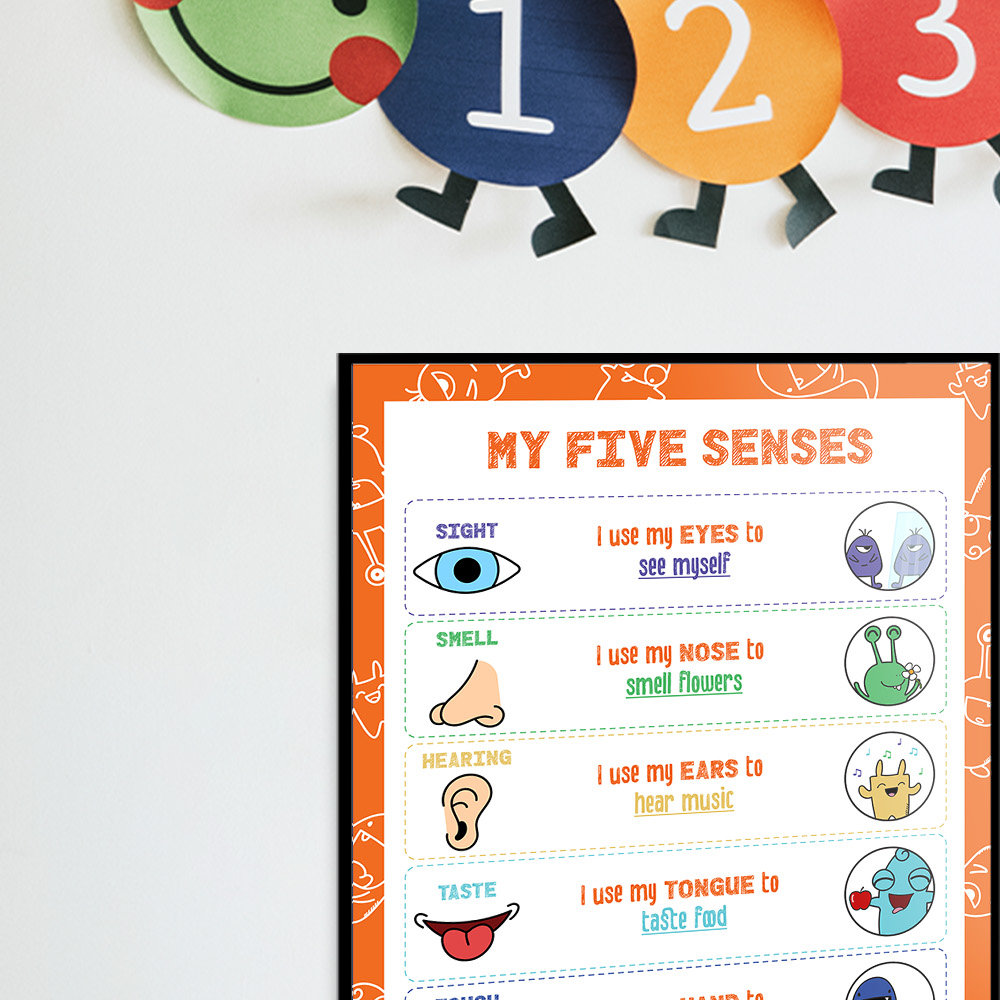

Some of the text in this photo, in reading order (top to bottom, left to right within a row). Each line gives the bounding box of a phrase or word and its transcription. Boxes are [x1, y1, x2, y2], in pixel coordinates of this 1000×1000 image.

[466, 0, 554, 134] 1
[664, 0, 773, 132] 2
[897, 0, 976, 98] 3
[488, 428, 873, 469] MY FIVE SENSES
[436, 522, 498, 540] SIGHT
[597, 521, 764, 550] I use my EYES to
[639, 551, 731, 580] see myself
[436, 629, 499, 648] SMELL
[596, 638, 764, 668] I use my NOSE to
[626, 670, 742, 695] smell flowers
[422, 749, 512, 769] HEARING
[597, 756, 763, 787] I use my EARS to
[635, 786, 734, 814] hear music
[438, 881, 497, 901] TASTE
[580, 871, 779, 906] I use my TONGUE to
[642, 904, 727, 932] taste food
